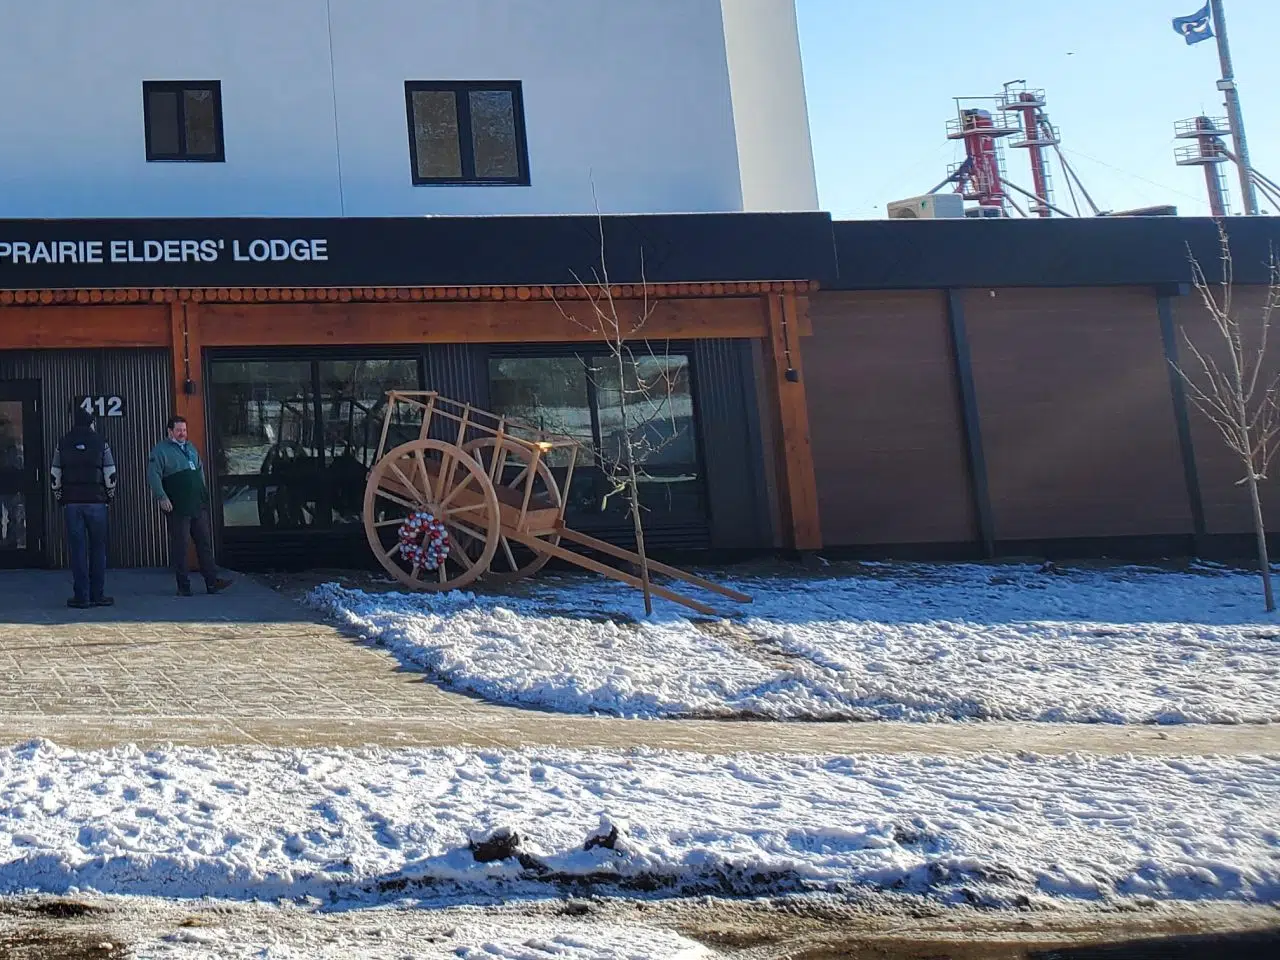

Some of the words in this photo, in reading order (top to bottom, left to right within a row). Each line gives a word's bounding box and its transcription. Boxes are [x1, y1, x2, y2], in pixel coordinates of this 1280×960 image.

[110, 239, 225, 262] ELDERS'
[233, 239, 329, 261] LODGE
[80, 396, 122, 417] 412
